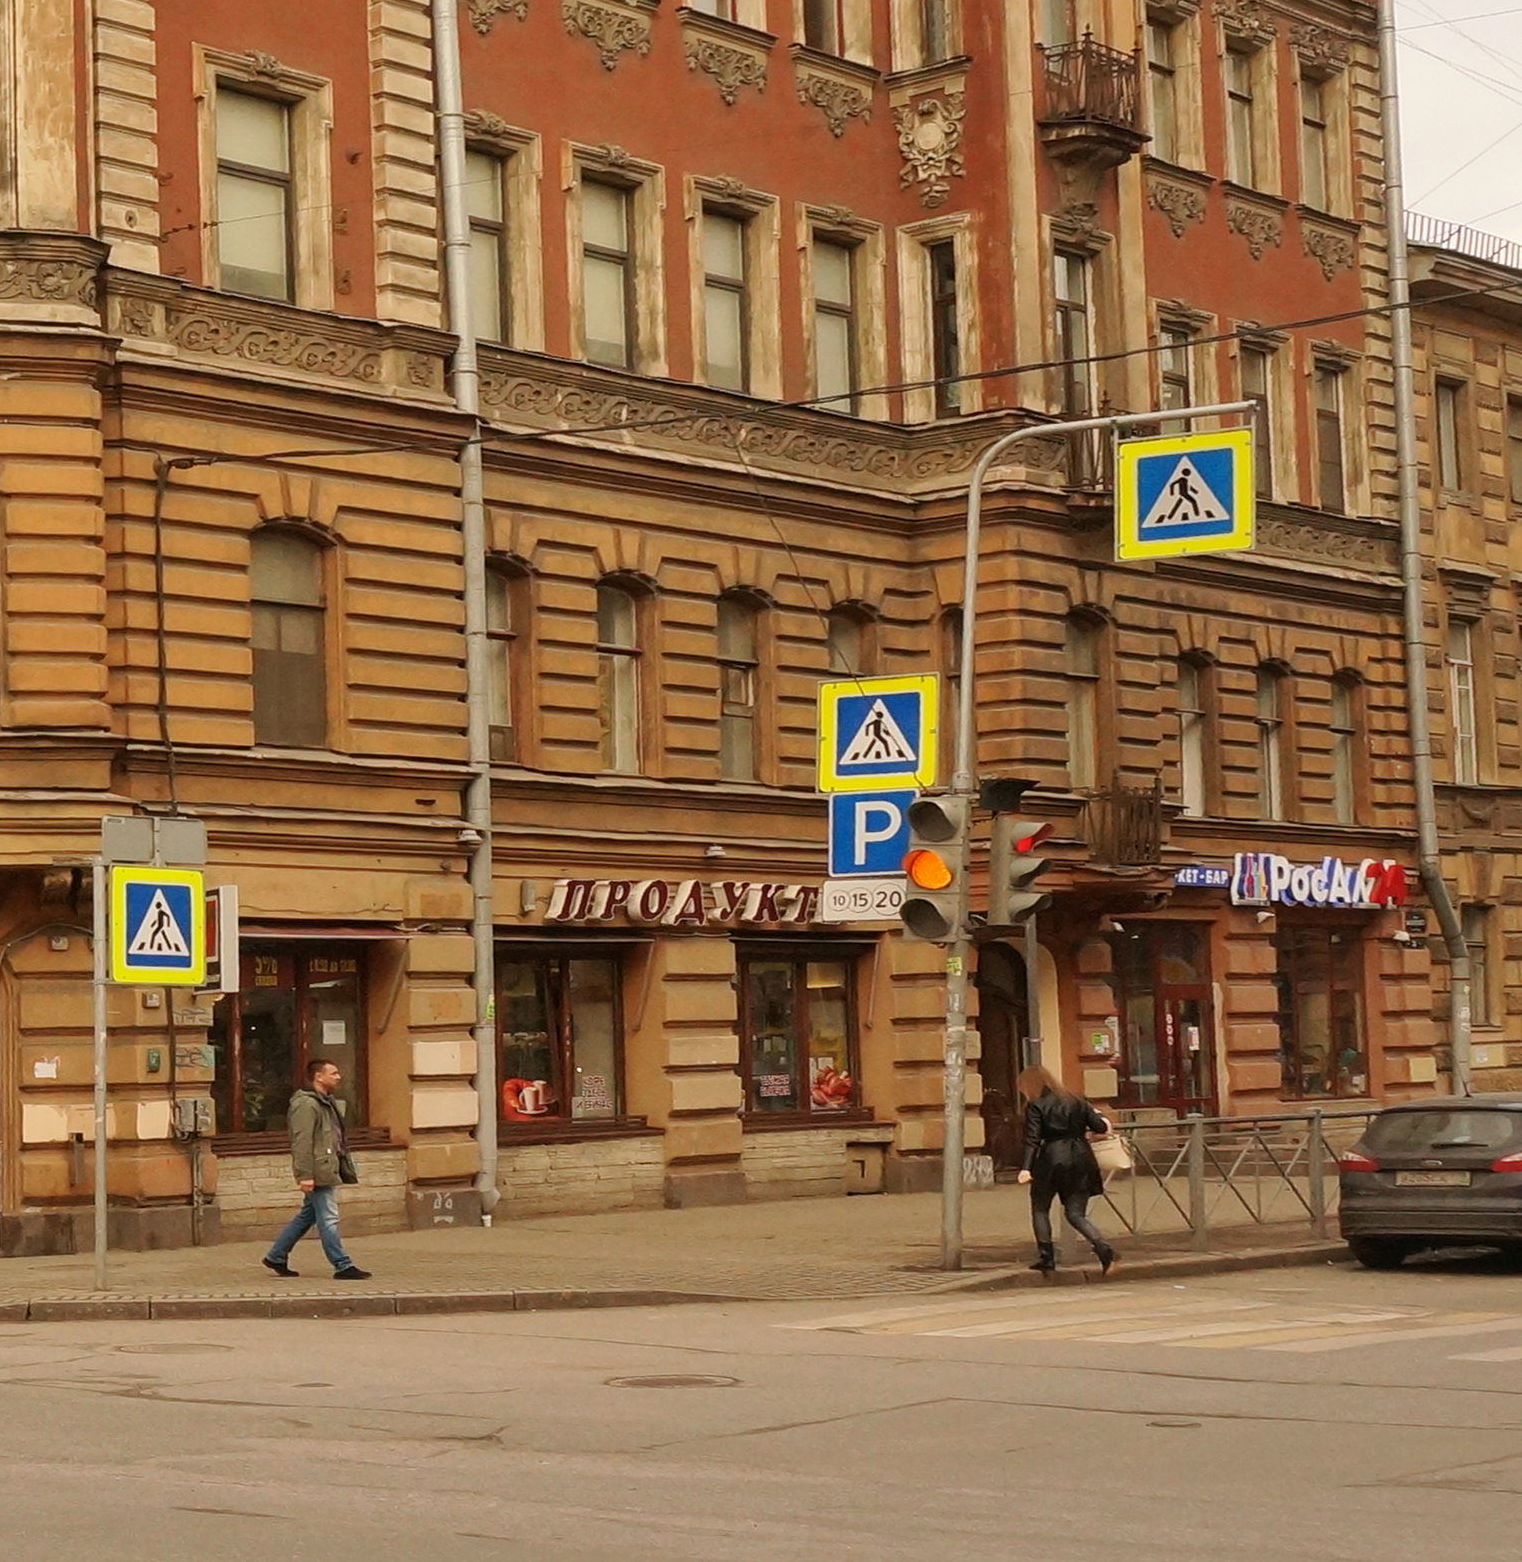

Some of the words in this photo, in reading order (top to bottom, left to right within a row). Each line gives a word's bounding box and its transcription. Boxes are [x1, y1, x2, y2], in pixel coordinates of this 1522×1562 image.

[854, 801, 902, 866] P
[1174, 869, 1229, 885] КЕТ-БАР
[556, 879, 820, 926] ПРОДУКТ
[832, 895, 846, 907] 10
[852, 893, 869, 907] 15
[875, 890, 903, 909] 20
